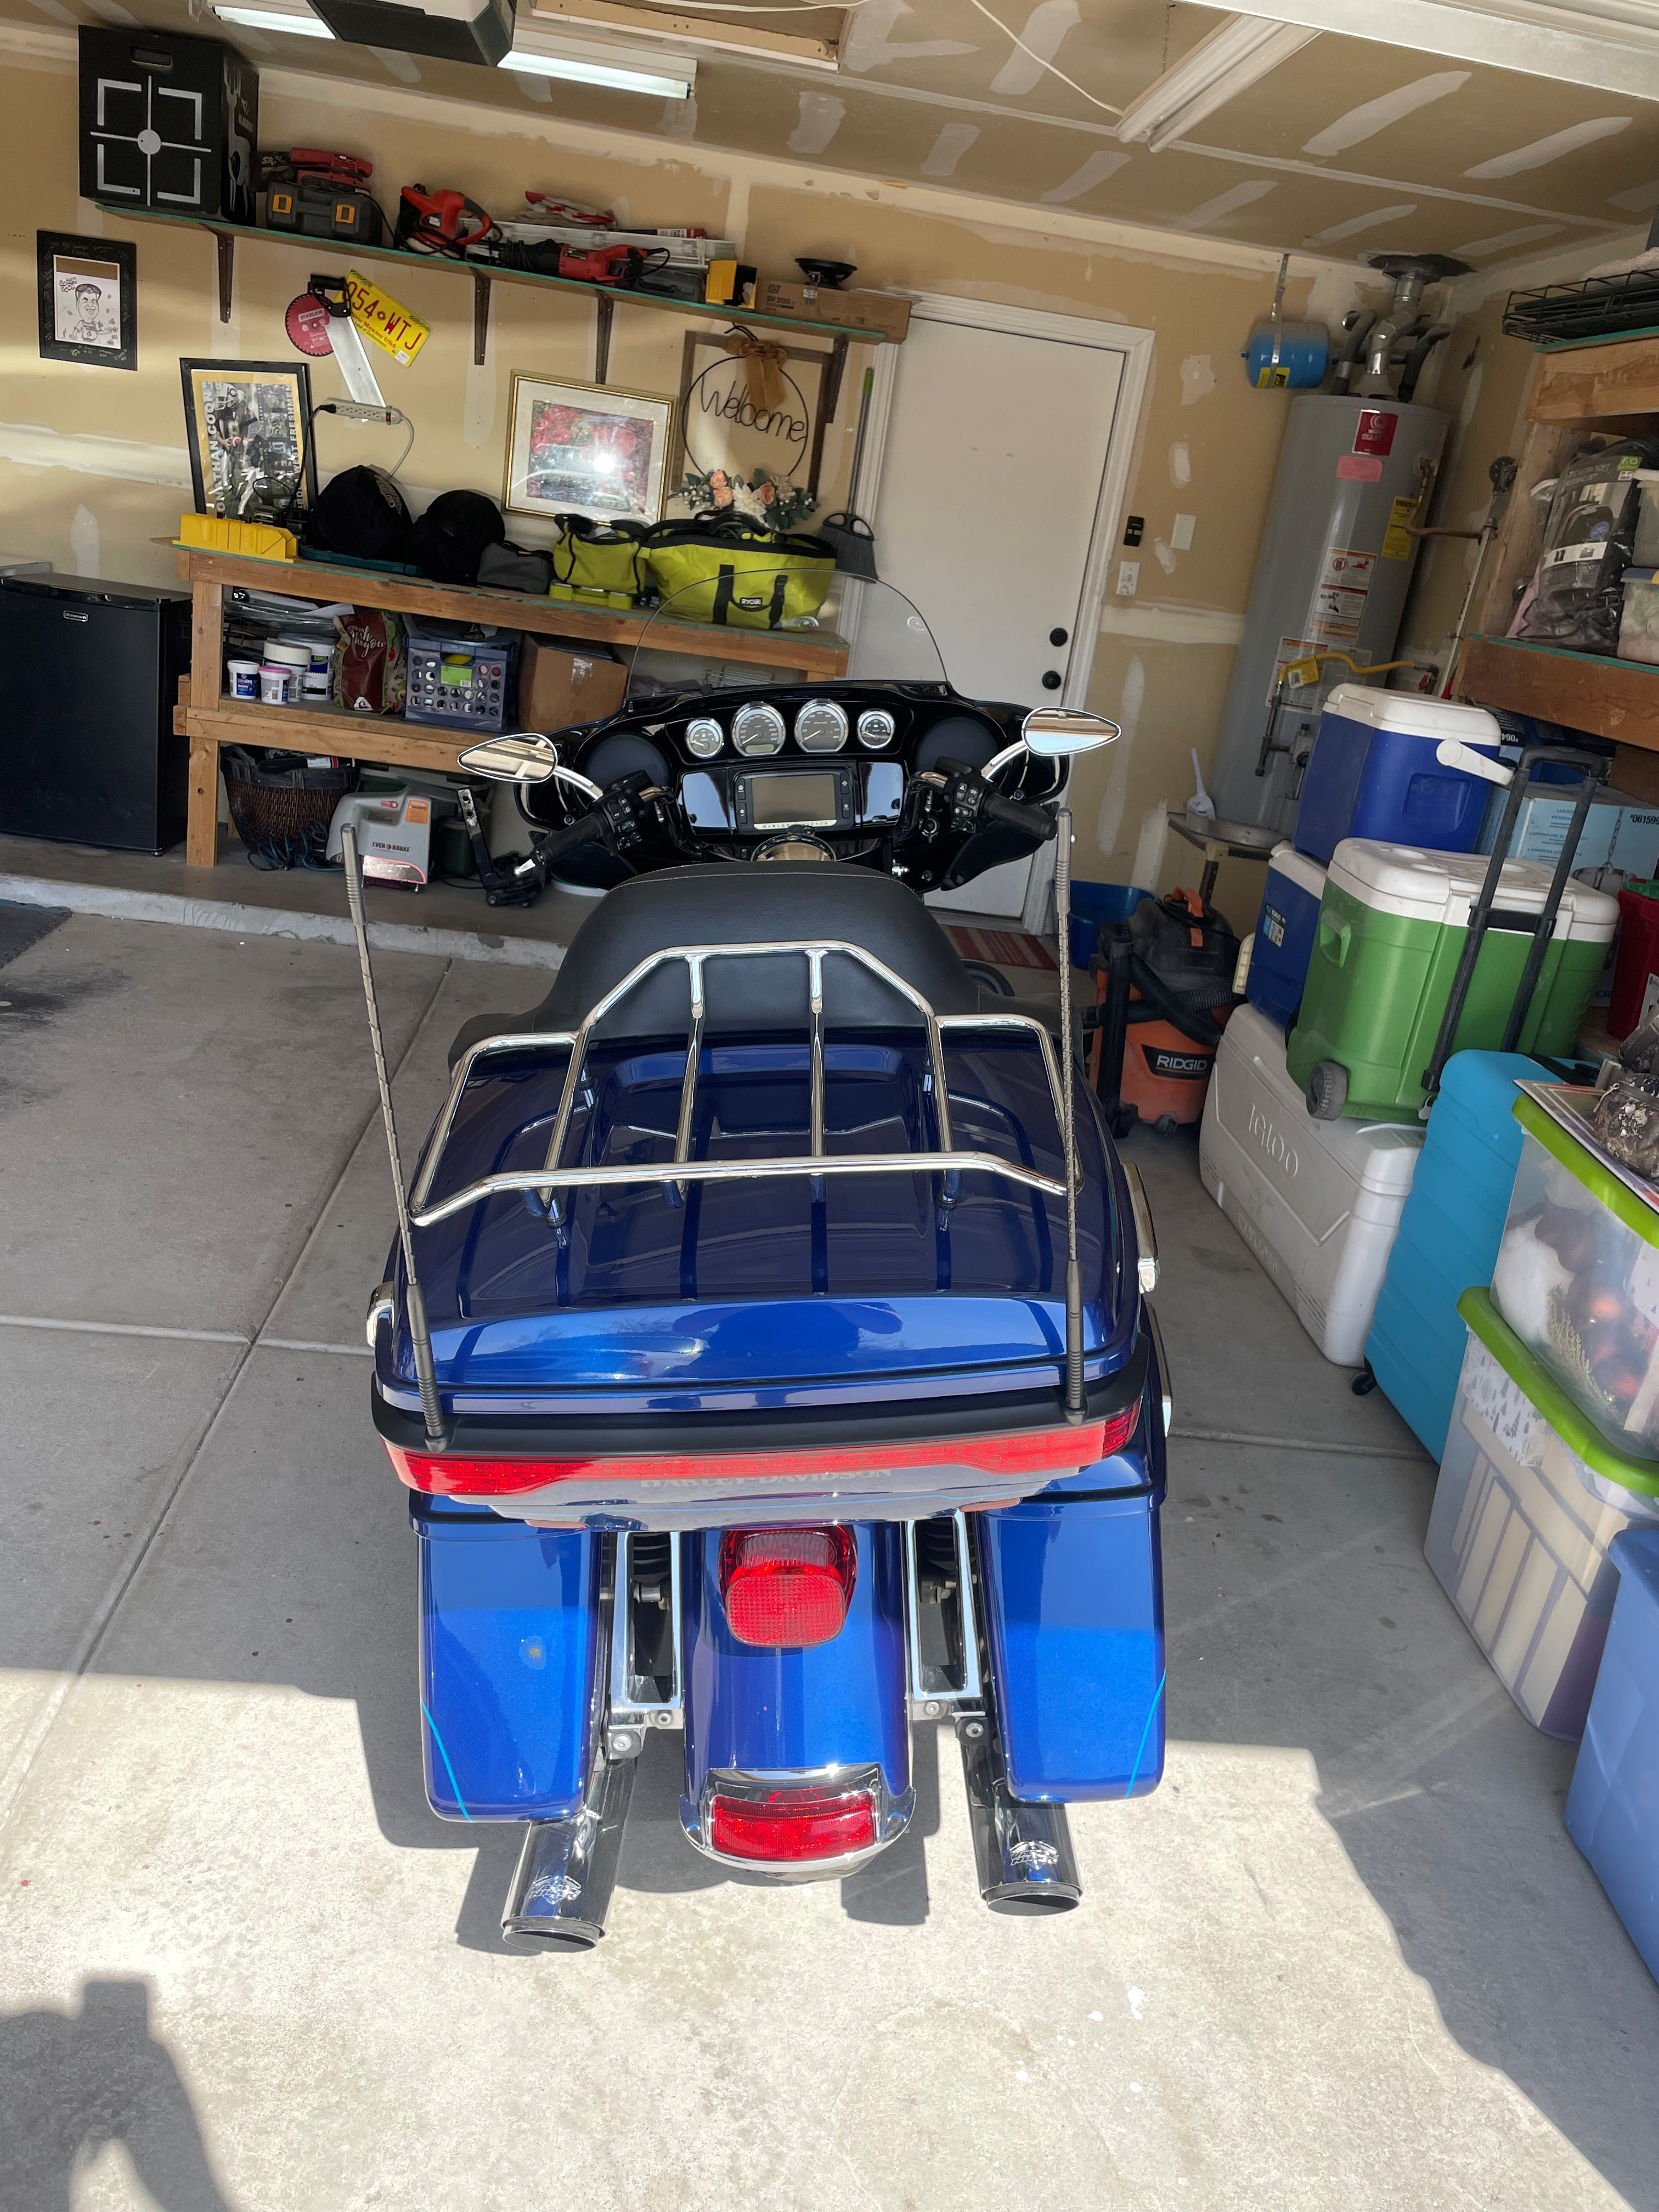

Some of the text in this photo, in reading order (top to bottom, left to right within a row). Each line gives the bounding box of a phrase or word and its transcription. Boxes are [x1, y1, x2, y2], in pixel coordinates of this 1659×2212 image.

[363, 320, 383, 338] Mexico
[383, 336, 396, 349] USA
[383, 311, 422, 350] WTJ
[286, 385, 297, 442] FRESHMEN
[701, 375, 808, 442] Welcome
[291, 445, 301, 474] WEST
[362, 639, 386, 658] you
[1156, 1054, 1207, 1070] RIDGID
[1248, 1104, 1299, 1178] IGLOO
